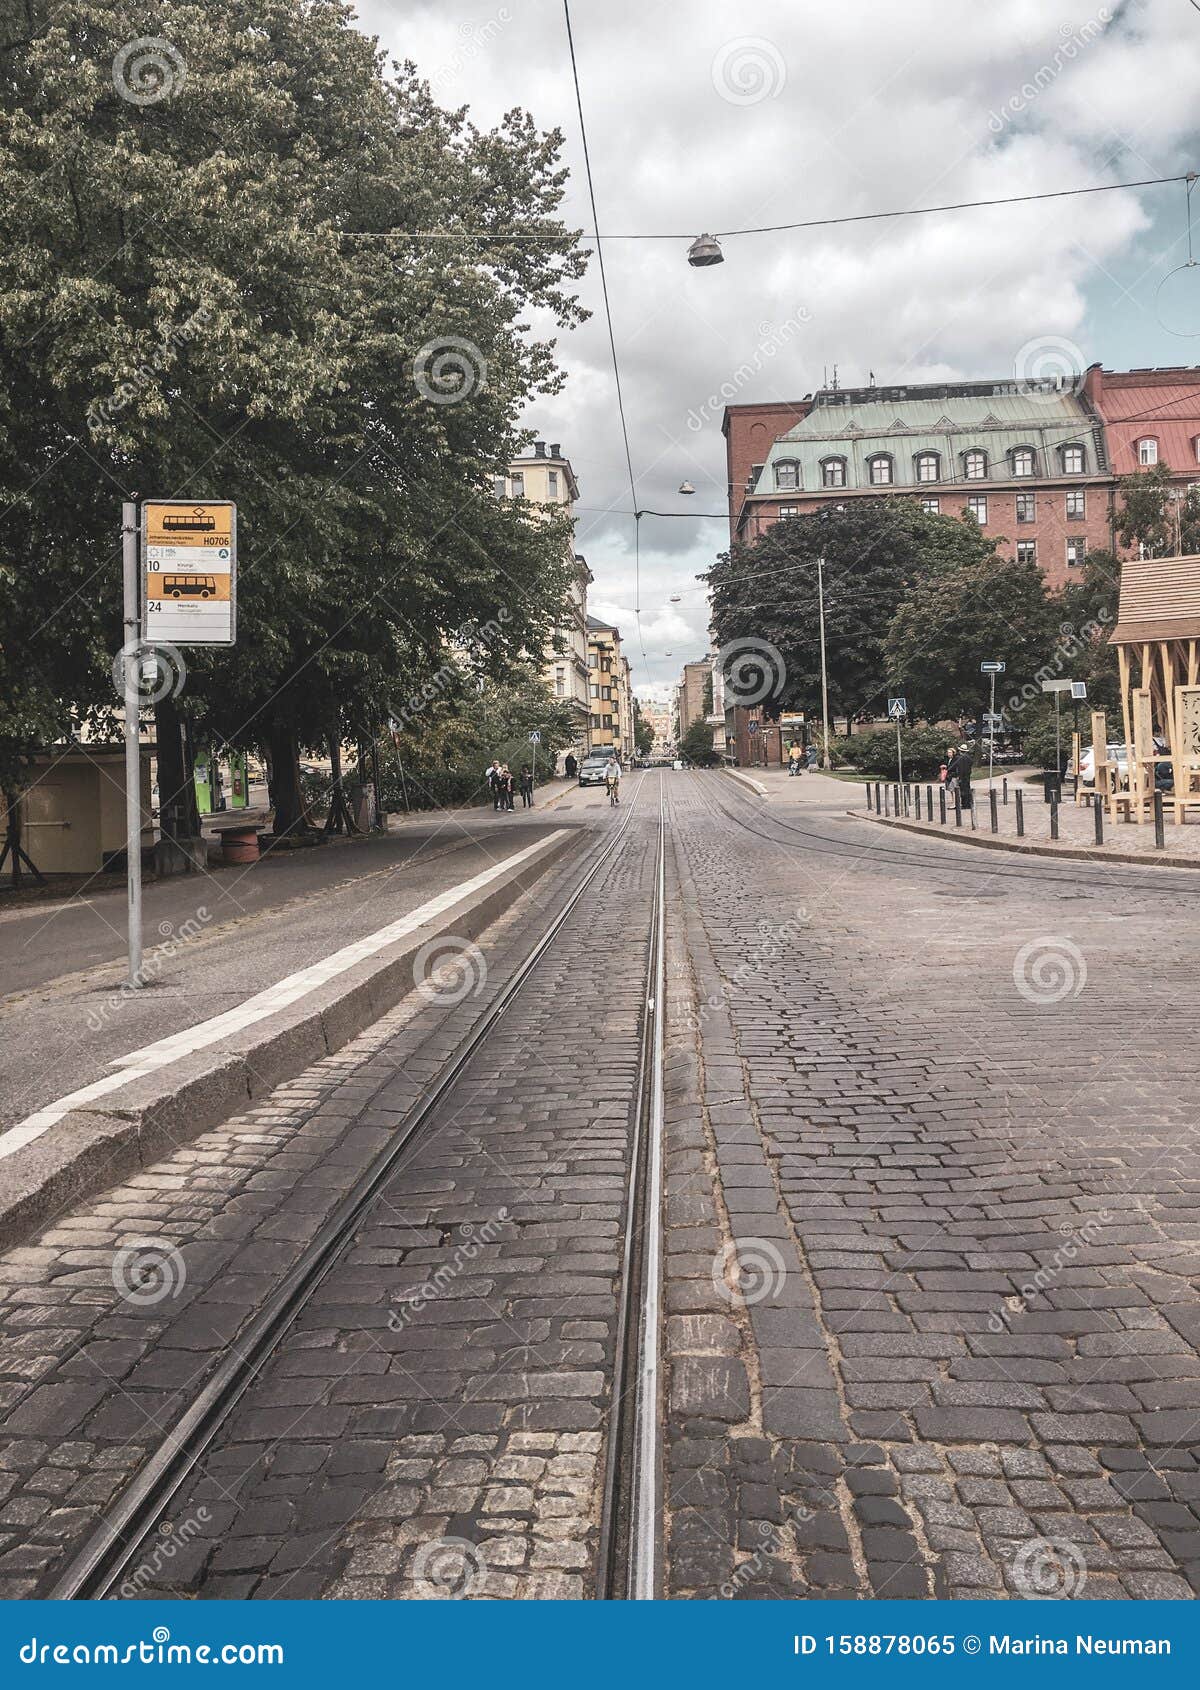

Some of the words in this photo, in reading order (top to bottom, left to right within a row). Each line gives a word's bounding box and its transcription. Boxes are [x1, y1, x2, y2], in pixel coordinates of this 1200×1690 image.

[204, 537, 229, 546] H0706
[149, 561, 160, 571] 10
[149, 602, 162, 612] 24
